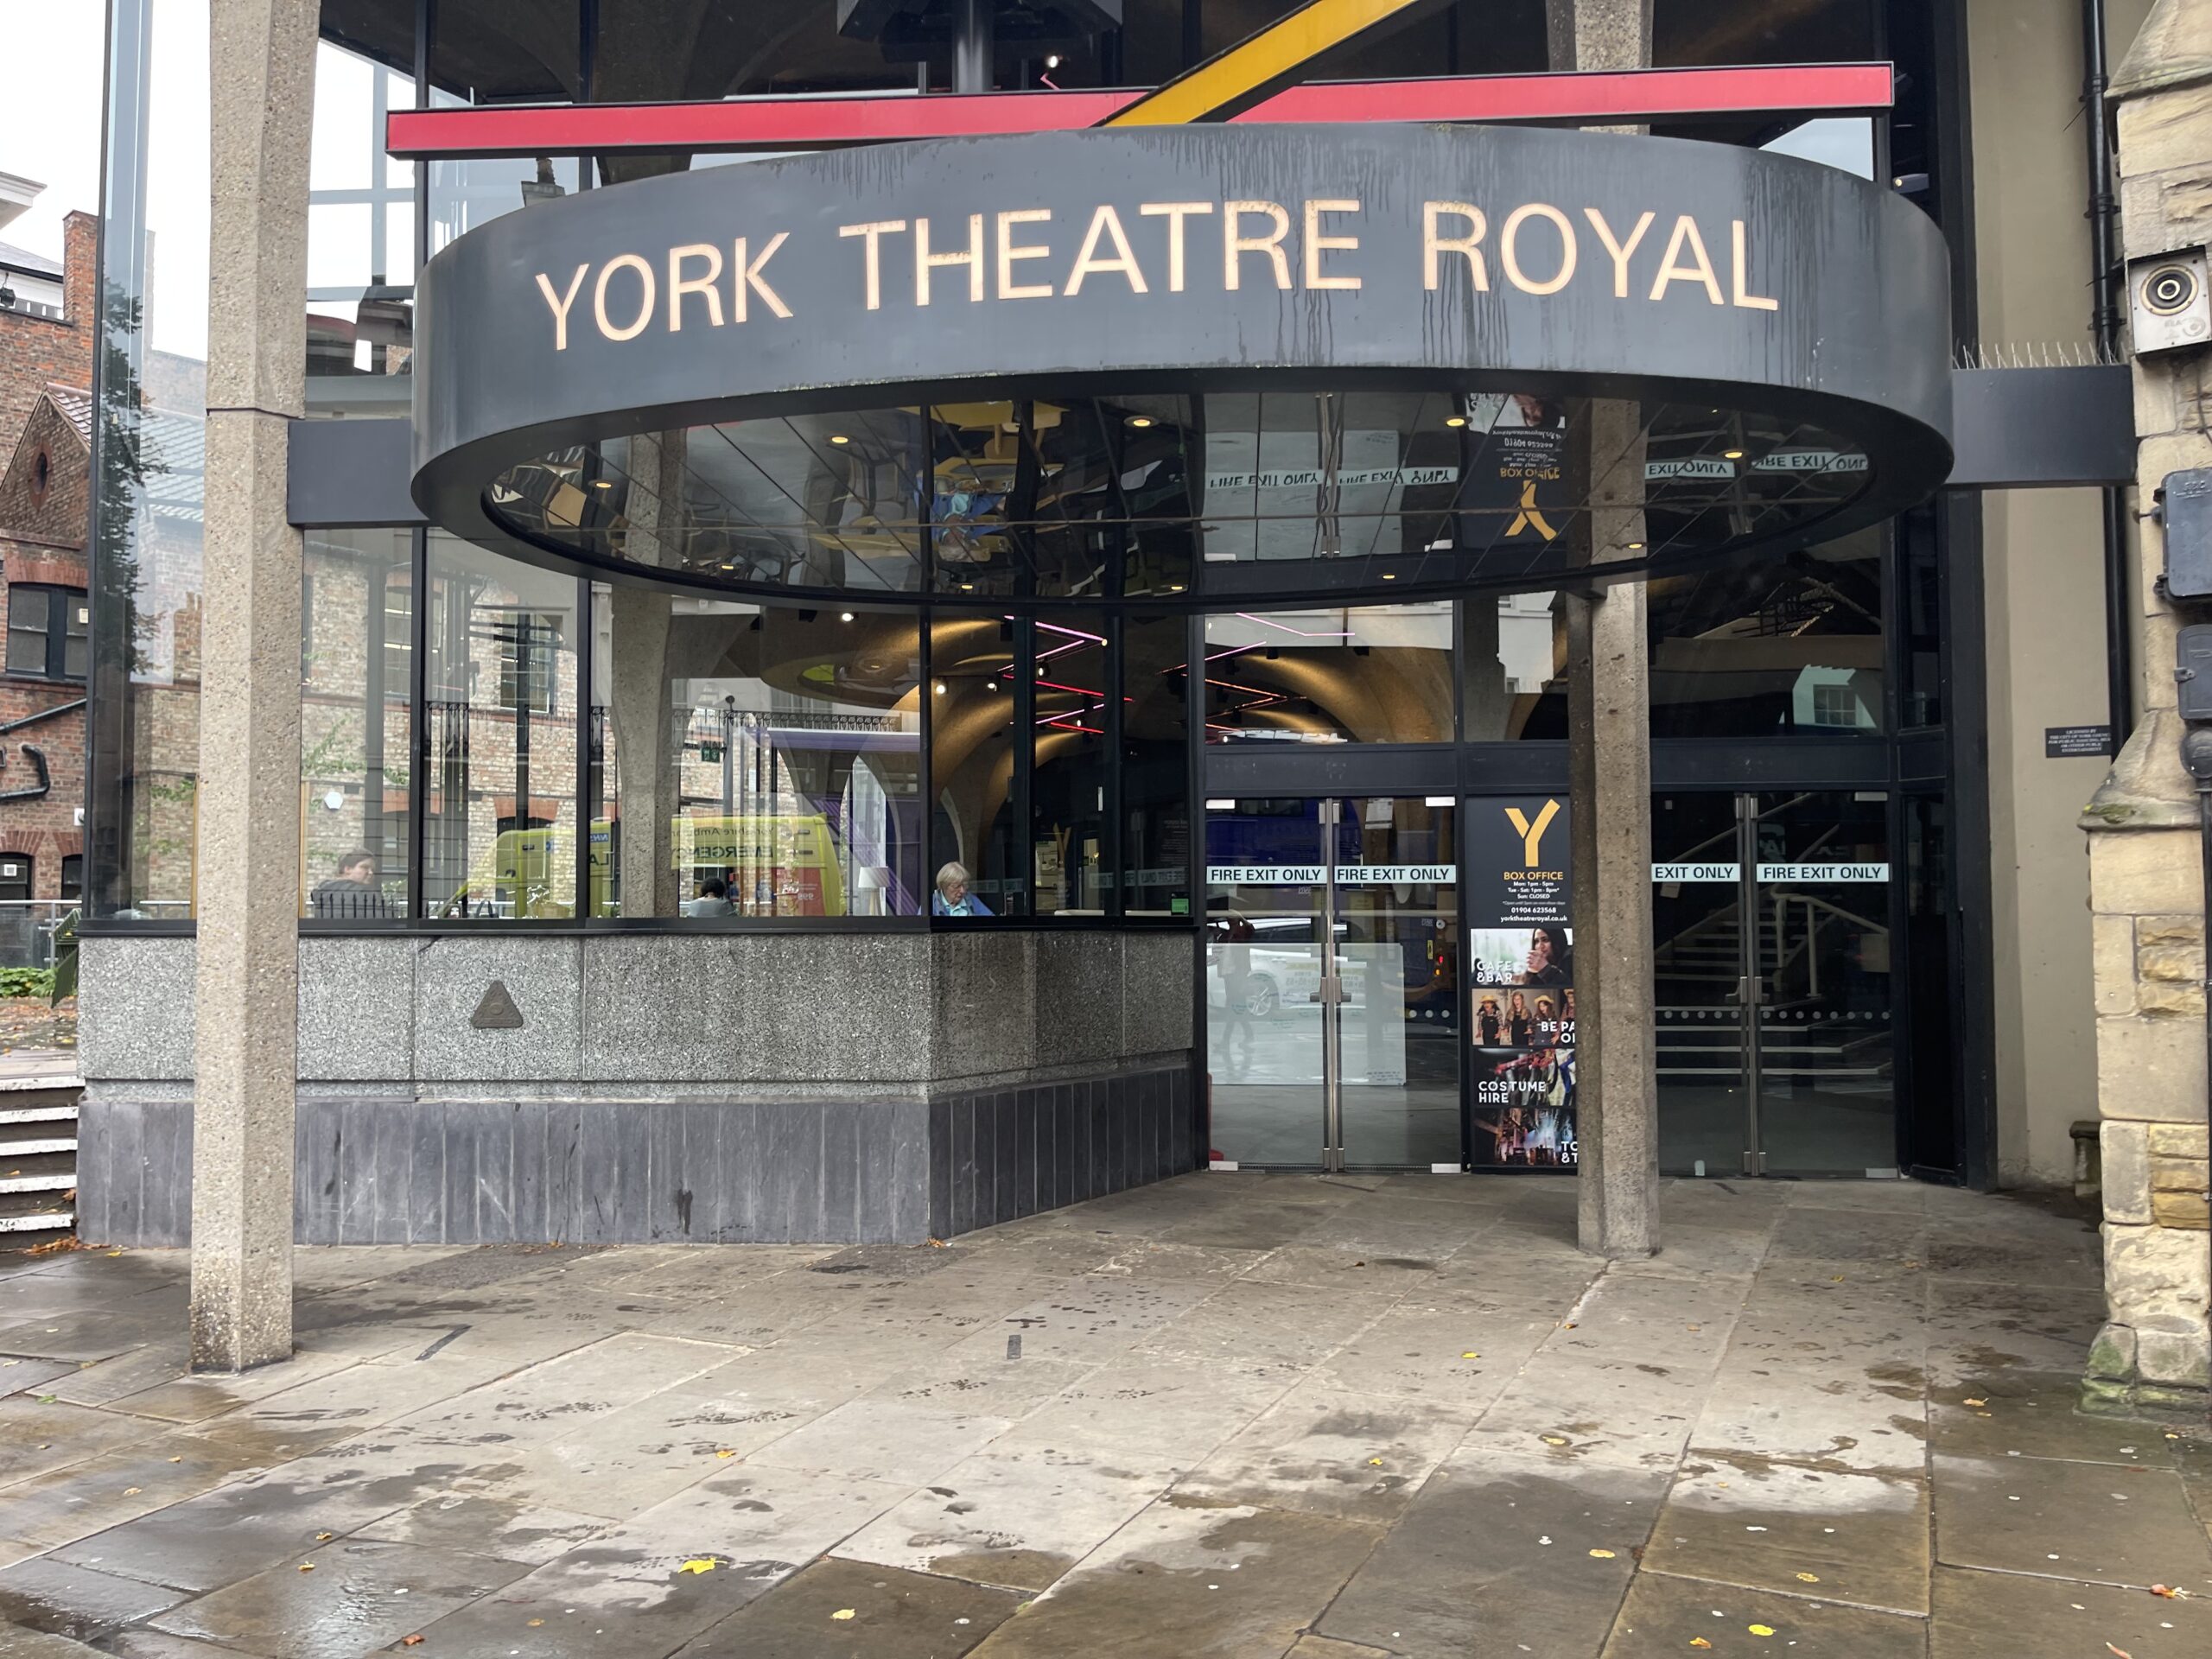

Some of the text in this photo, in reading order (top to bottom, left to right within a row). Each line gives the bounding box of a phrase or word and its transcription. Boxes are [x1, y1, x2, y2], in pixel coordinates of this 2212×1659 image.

[535, 200, 1779, 351] YORK THEATRE ROYAL
[1211, 869, 1321, 881] FIRE EXIT ONLY
[1337, 868, 1449, 880] FIRE EXIT ONLY
[1503, 872, 1563, 880] BOX OFFICE
[1655, 867, 1734, 879] EXIT ONLY
[1764, 867, 1882, 880] FIRE EXIT ONLY
[1541, 1021, 1558, 1032] BE
[1478, 1081, 1546, 1092] COSTUME
[1478, 1092, 1509, 1103] HIRE
